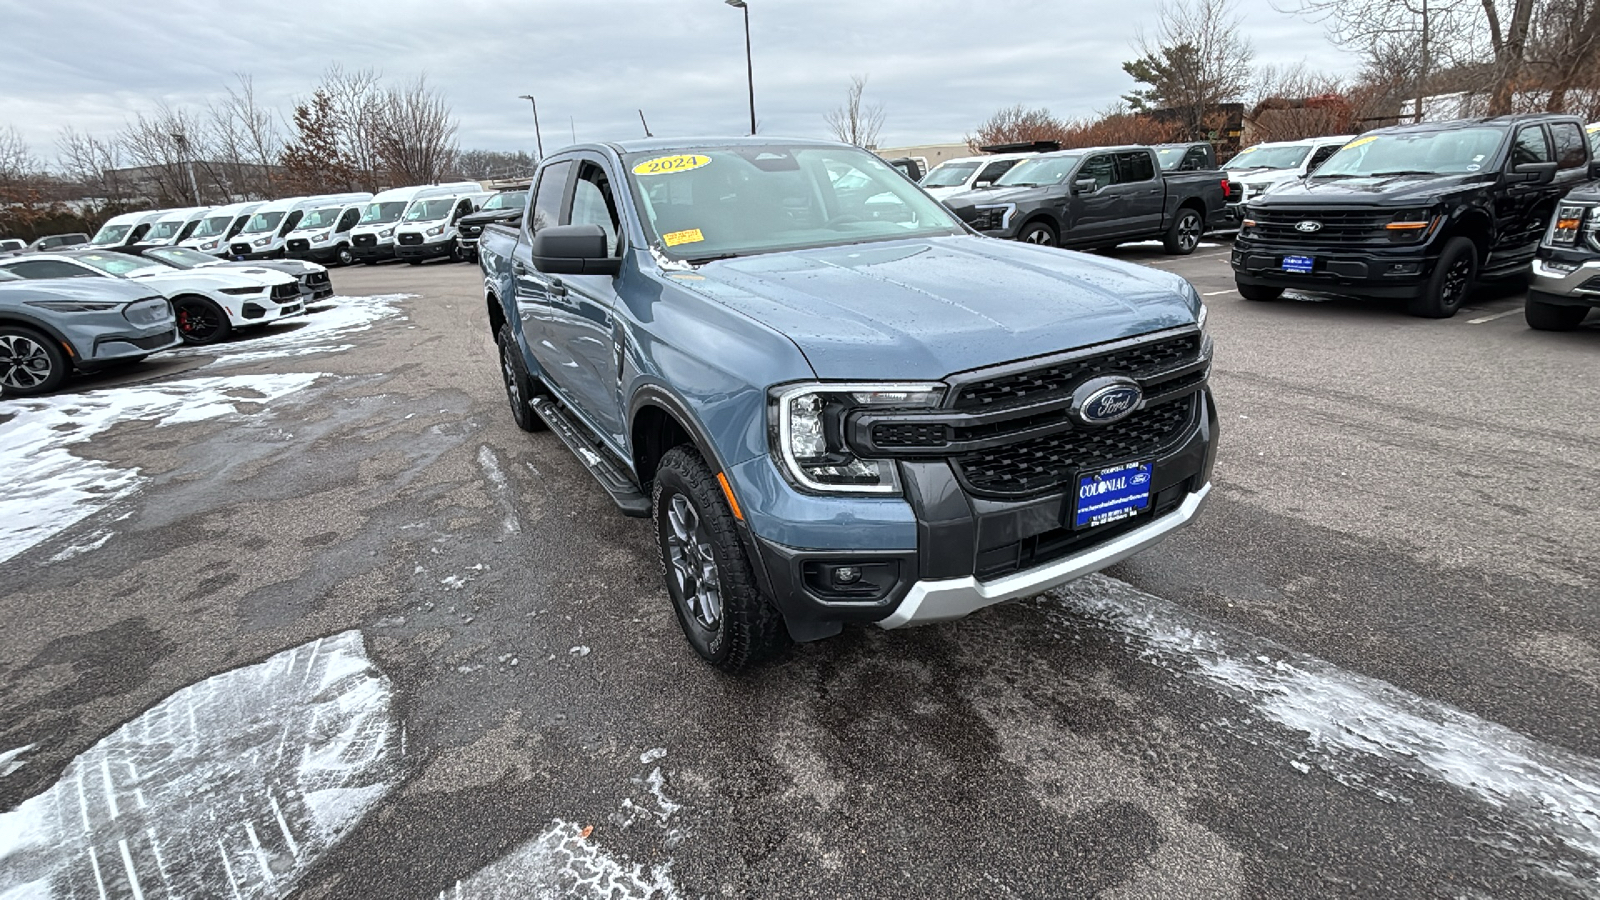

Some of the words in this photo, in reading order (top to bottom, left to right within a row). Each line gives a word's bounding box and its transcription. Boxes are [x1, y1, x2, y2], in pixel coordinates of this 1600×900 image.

[648, 156, 698, 173] 2024
[1097, 392, 1130, 418] Ford
[1080, 476, 1127, 499] COLONIAL
